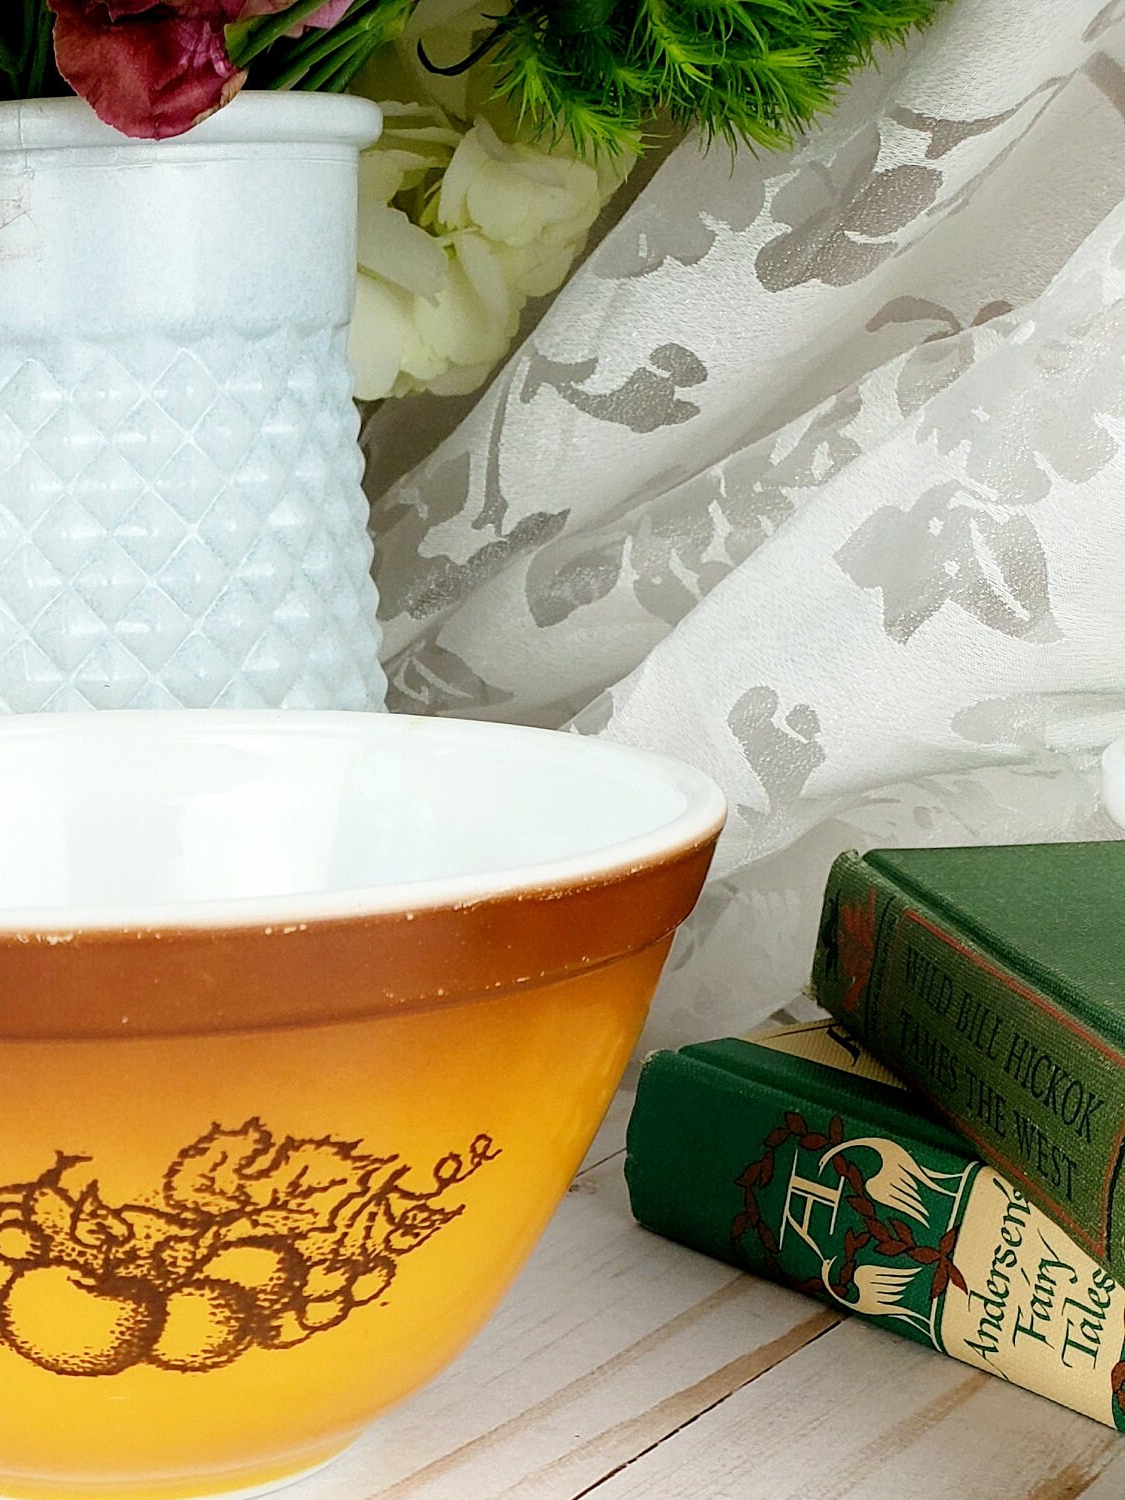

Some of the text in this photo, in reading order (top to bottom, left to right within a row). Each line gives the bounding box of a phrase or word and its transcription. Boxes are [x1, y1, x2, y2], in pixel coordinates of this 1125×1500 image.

[899, 1008, 959, 1093] TAMES
[965, 1066, 1007, 1138] THE
[1013, 1109, 1077, 1201] WEST
[905, 945, 1104, 1146] WILD BILL HICKOK
[1012, 1227, 1079, 1350] Fairy
[1061, 1267, 1117, 1369] Tales
